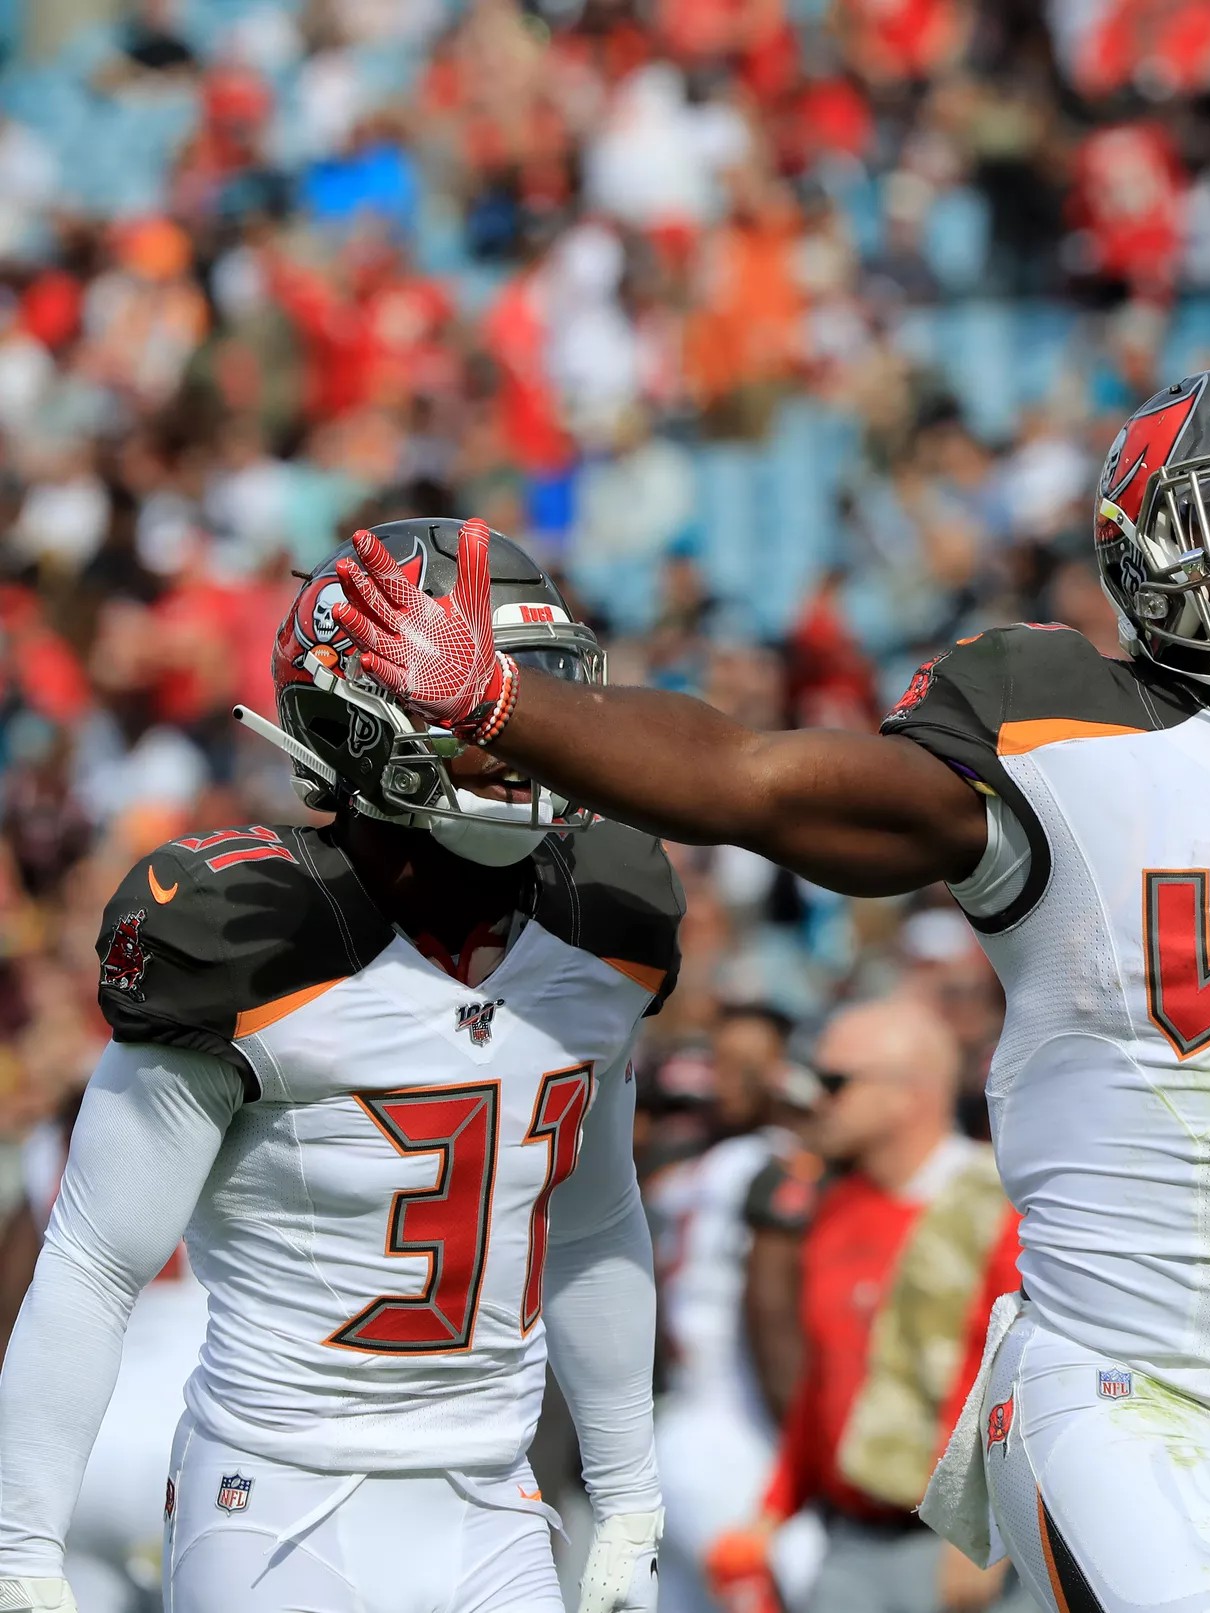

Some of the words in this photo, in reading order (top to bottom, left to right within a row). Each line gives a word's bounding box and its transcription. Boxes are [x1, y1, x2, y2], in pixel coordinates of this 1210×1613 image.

[320, 1060, 595, 1357] 31
[1102, 1382, 1128, 1396] NFL
[220, 1488, 246, 1508] NFL
